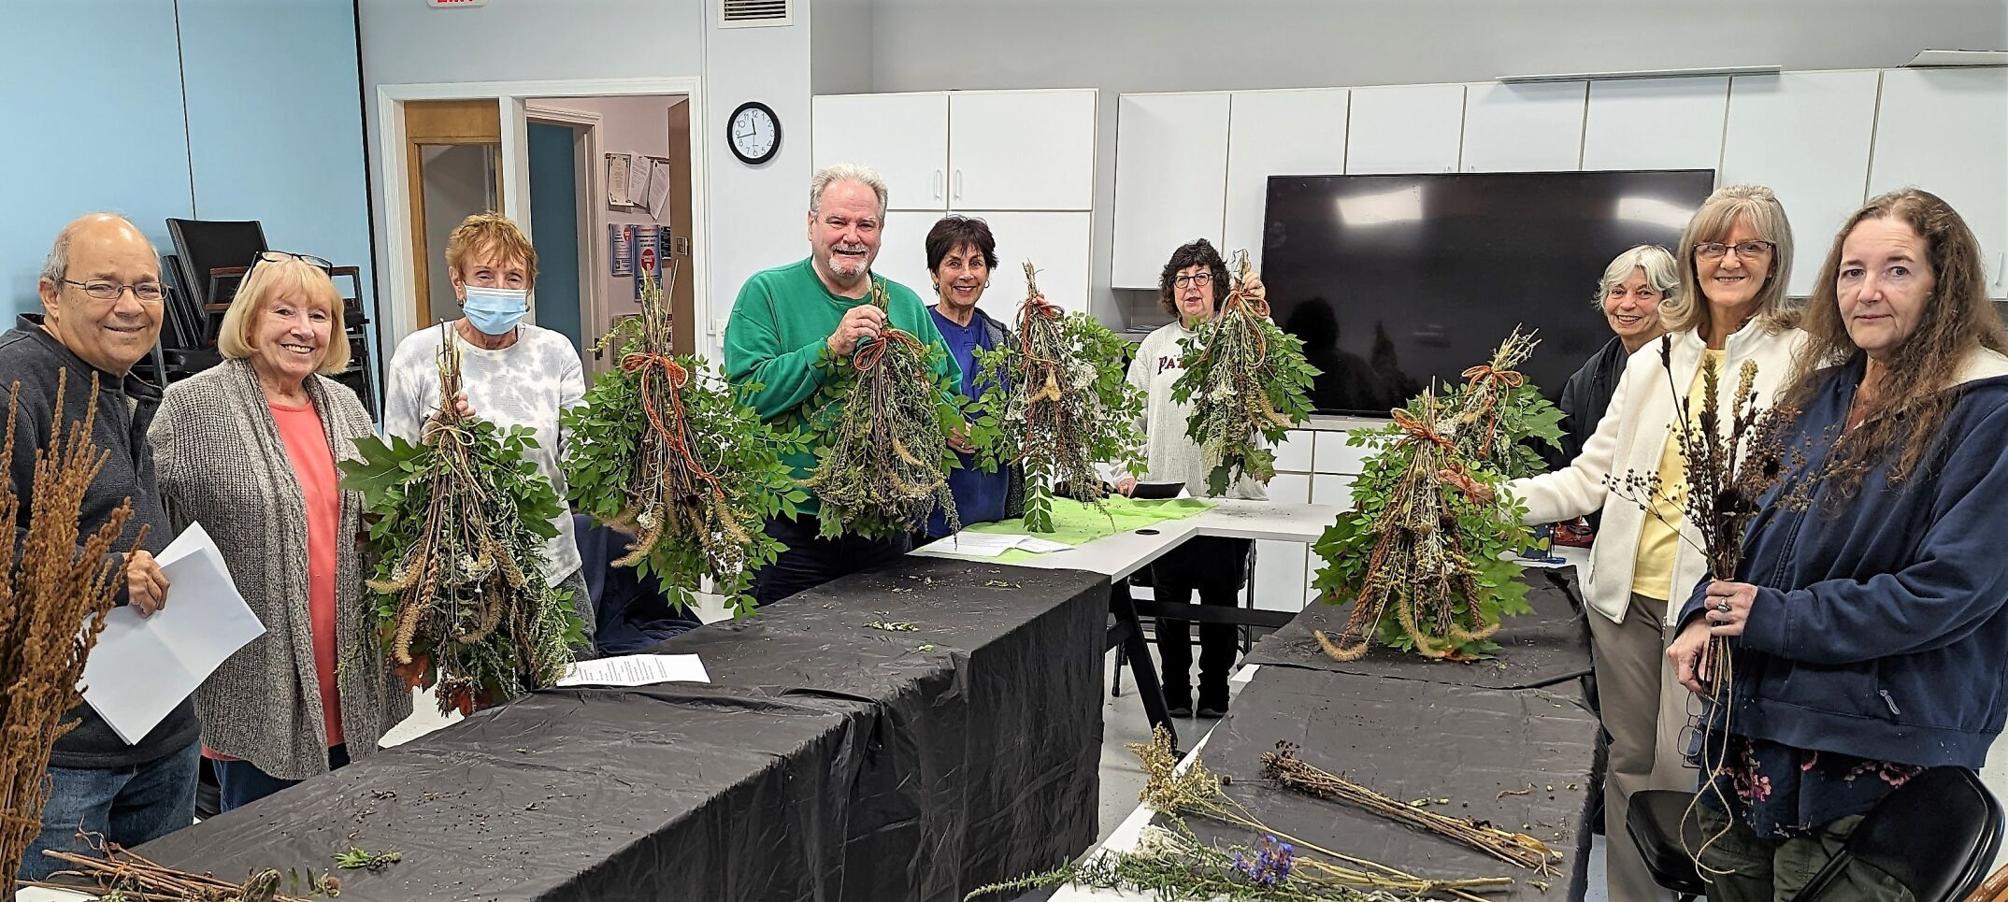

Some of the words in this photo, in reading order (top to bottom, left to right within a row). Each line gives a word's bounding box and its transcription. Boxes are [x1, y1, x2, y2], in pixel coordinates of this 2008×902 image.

[752, 110, 758, 118] 12
[736, 120, 745, 128] 10
[746, 147, 750, 155] 7
